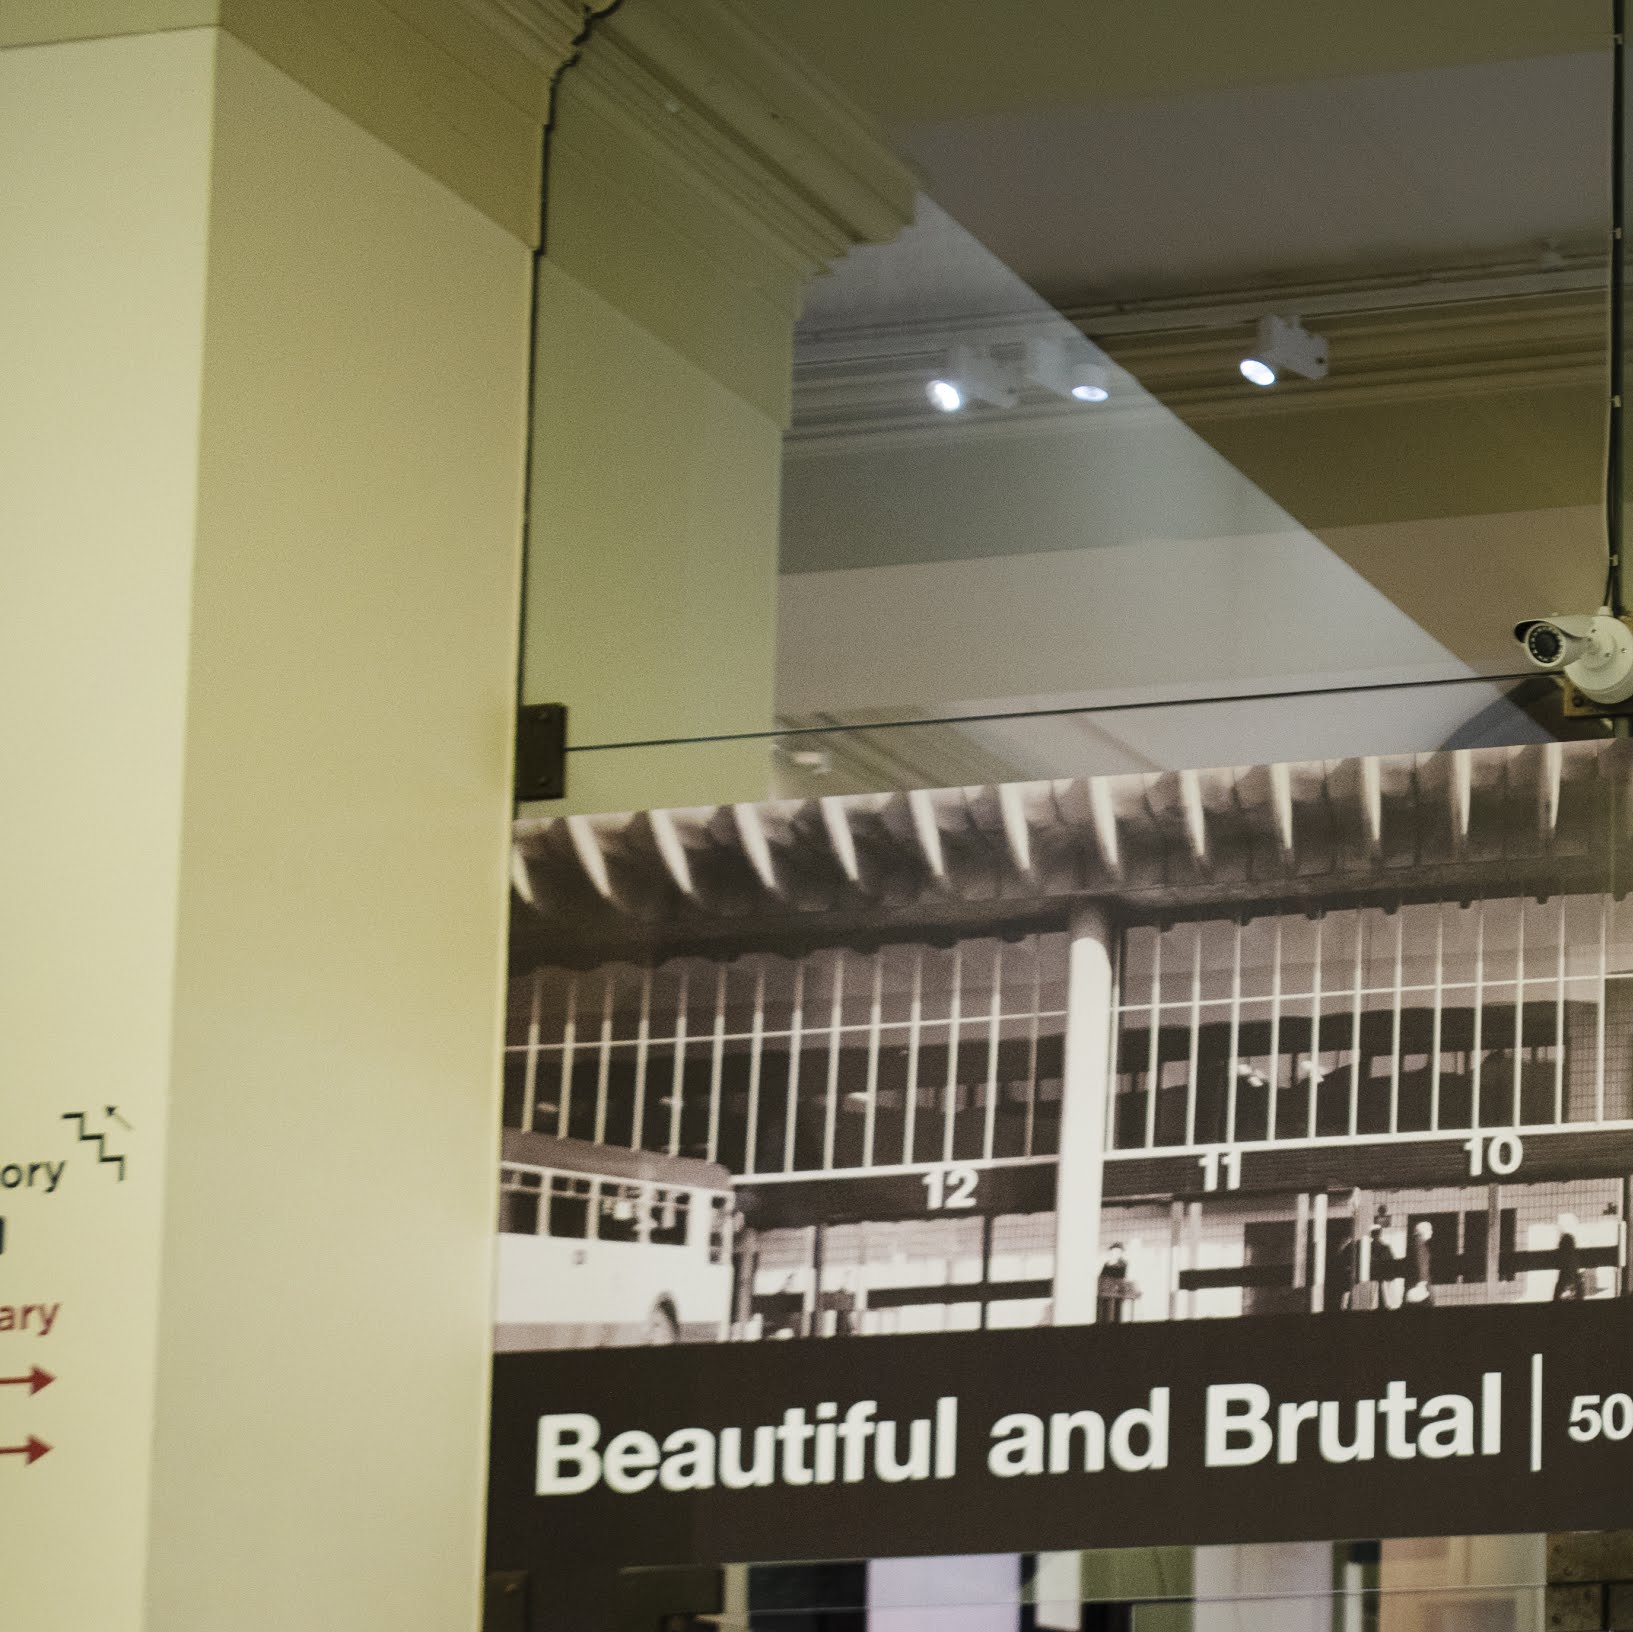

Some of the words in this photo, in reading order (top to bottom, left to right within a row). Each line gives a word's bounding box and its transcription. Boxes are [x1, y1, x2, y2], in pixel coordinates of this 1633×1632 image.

[1198, 1151, 1242, 1192] 11
[1462, 1136, 1524, 1178] 10
[922, 1167, 979, 1211] 12
[534, 1396, 957, 1497] Beautiful
[987, 1387, 1170, 1477] and
[1204, 1372, 1503, 1468] Brutal
